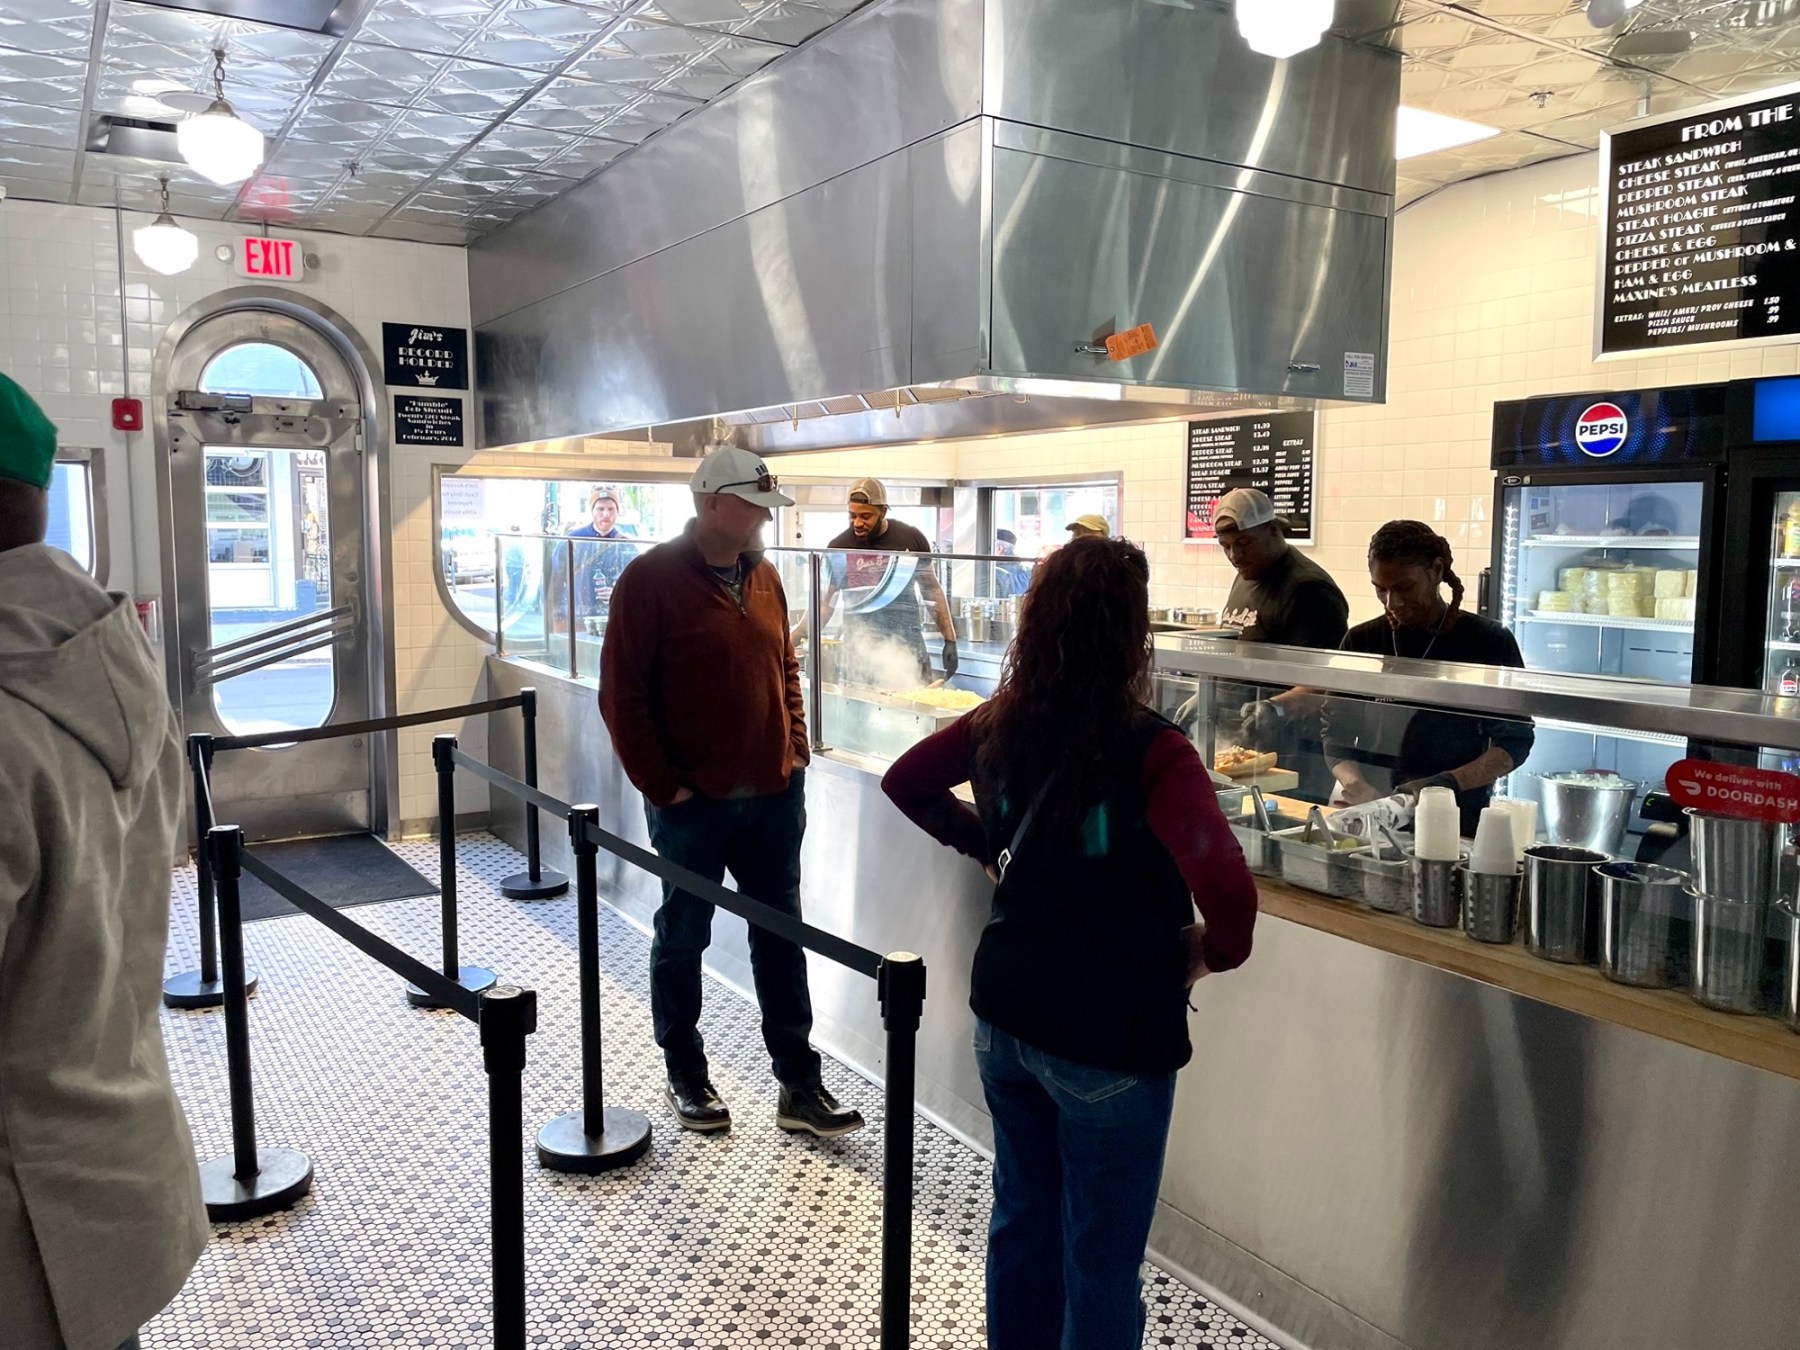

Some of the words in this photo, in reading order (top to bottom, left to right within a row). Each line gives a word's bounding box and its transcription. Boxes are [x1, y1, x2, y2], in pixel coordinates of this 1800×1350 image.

[1681, 115, 1743, 142] FROM
[1748, 103, 1793, 127] THE
[1619, 157, 1662, 175] STEAK
[1665, 140, 1742, 166] SANDWICH
[1618, 169, 1671, 189] CHEESE
[1674, 159, 1720, 178] STEAK
[1616, 194, 1698, 218] MUSHROOM
[1701, 184, 1748, 203] STEAK
[1617, 184, 1674, 204] PEPPER
[1677, 174, 1723, 192] STEAK
[1616, 216, 1660, 232] STEAK
[1663, 205, 1718, 224] HOAGIE
[1722, 203, 1752, 214] LETTUCE
[1758, 195, 1795, 208] TOMATOES
[1616, 231, 1656, 247] PIZZA
[1659, 222, 1705, 240] STEAK
[1711, 221, 1737, 231] CHEESE
[1742, 216, 1762, 226] PIZZA
[1763, 212, 1786, 223] SAUCE
[245, 238, 293, 276] EXIT
[1615, 243, 1668, 261] CHEESE
[1672, 241, 1682, 252] &
[1686, 236, 1717, 250] EGG
[1615, 258, 1671, 275] PEPPER
[1674, 256, 1690, 266] or
[1693, 241, 1781, 264] MUSHROOM
[1785, 238, 1797, 250] &
[1613, 285, 1678, 304] MAXINE'S
[1681, 274, 1757, 295] MEATLESS
[1614, 276, 1645, 289] HAM
[1648, 274, 1659, 285] &
[1663, 269, 1693, 283] EGG
[1614, 313, 1645, 323] EXTRAS:
[1648, 309, 1672, 319] WHIZ/
[1672, 305, 1700, 317] AMER/
[1700, 302, 1723, 313] PROV
[1723, 299, 1754, 310] CHEESE
[1648, 318, 1669, 328] PIZZA
[1671, 315, 1696, 325] SAUCE
[408, 328, 443, 345] Jim's
[1647, 325, 1687, 336] PEPPERS/
[1687, 319, 1739, 332] MUSHROOMS
[399, 347, 454, 359] RECORD
[399, 357, 454, 368] HOLDER
[1579, 423, 1624, 436] PEPSI
[1694, 768, 1713, 780] We
[1714, 773, 1755, 786] deliver
[1756, 779, 1782, 791] with
[1707, 785, 1798, 810] DOORDASH
